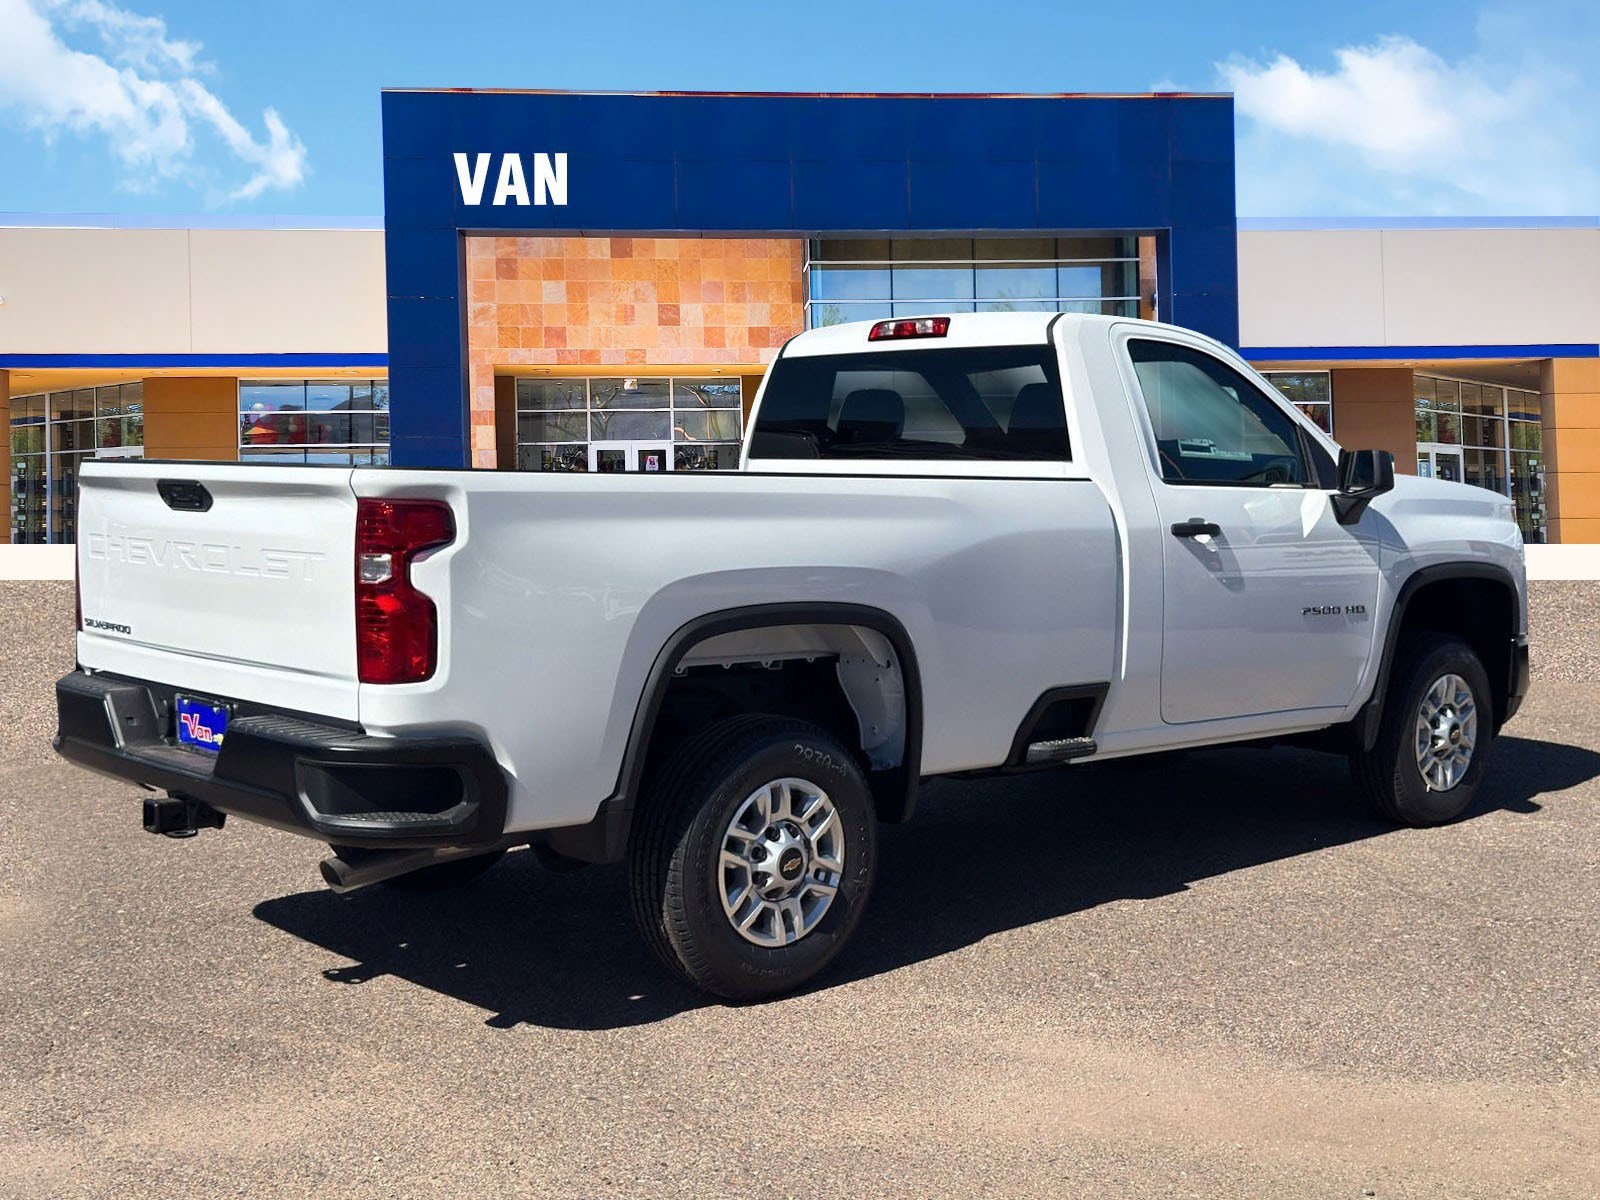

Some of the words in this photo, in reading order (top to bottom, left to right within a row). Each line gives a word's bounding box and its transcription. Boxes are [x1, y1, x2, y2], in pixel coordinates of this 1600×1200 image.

[453, 153, 568, 206] VAN
[89, 532, 325, 582] CHEVROLET
[1301, 606, 1341, 615] 2500
[1345, 605, 1365, 614] HD
[84, 617, 131, 634] SILVERADO
[181, 713, 213, 743] Van
